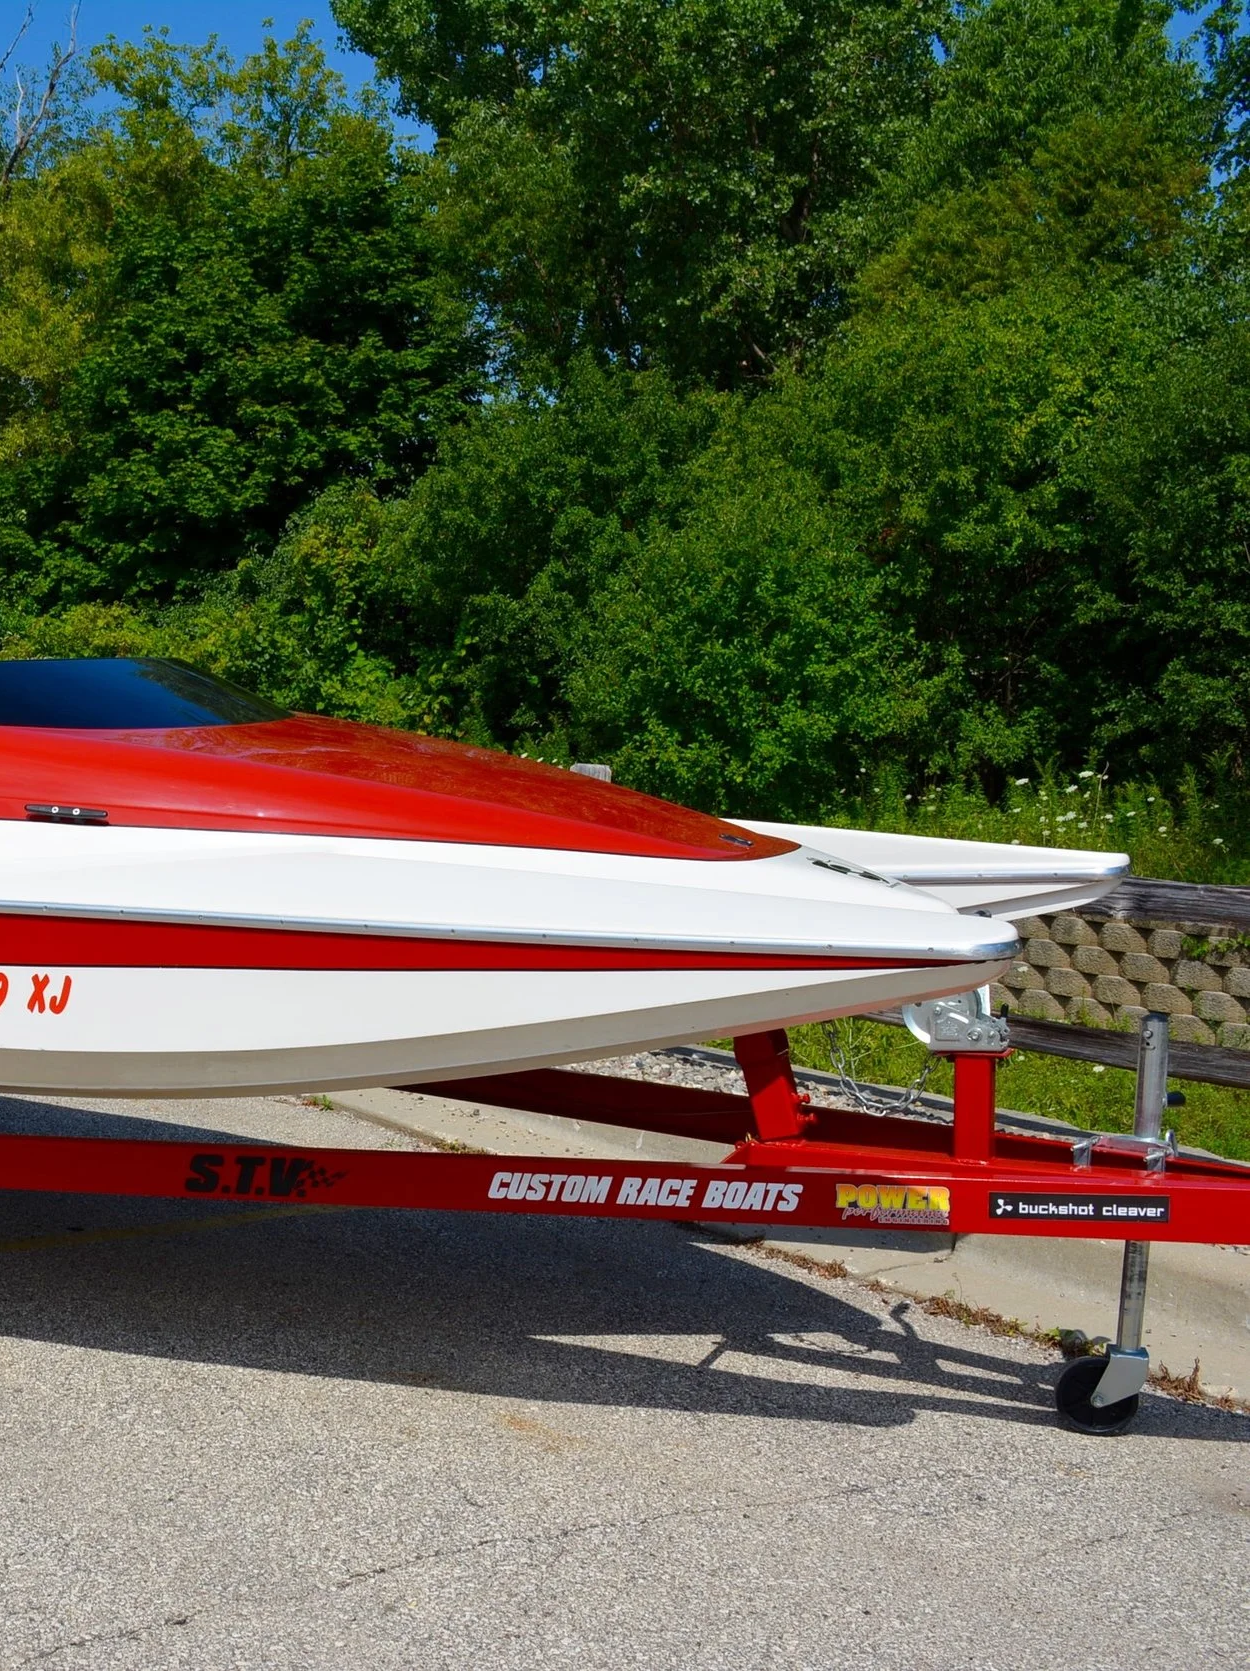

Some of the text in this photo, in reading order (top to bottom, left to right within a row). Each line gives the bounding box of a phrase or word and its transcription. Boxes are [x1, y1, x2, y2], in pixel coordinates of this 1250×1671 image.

[26, 973, 73, 1015] XJ
[487, 1171, 804, 1213] CUSTOM RACE BOATS
[835, 1183, 951, 1211] POWER
[1018, 1201, 1165, 1218] buckshot cleaver
